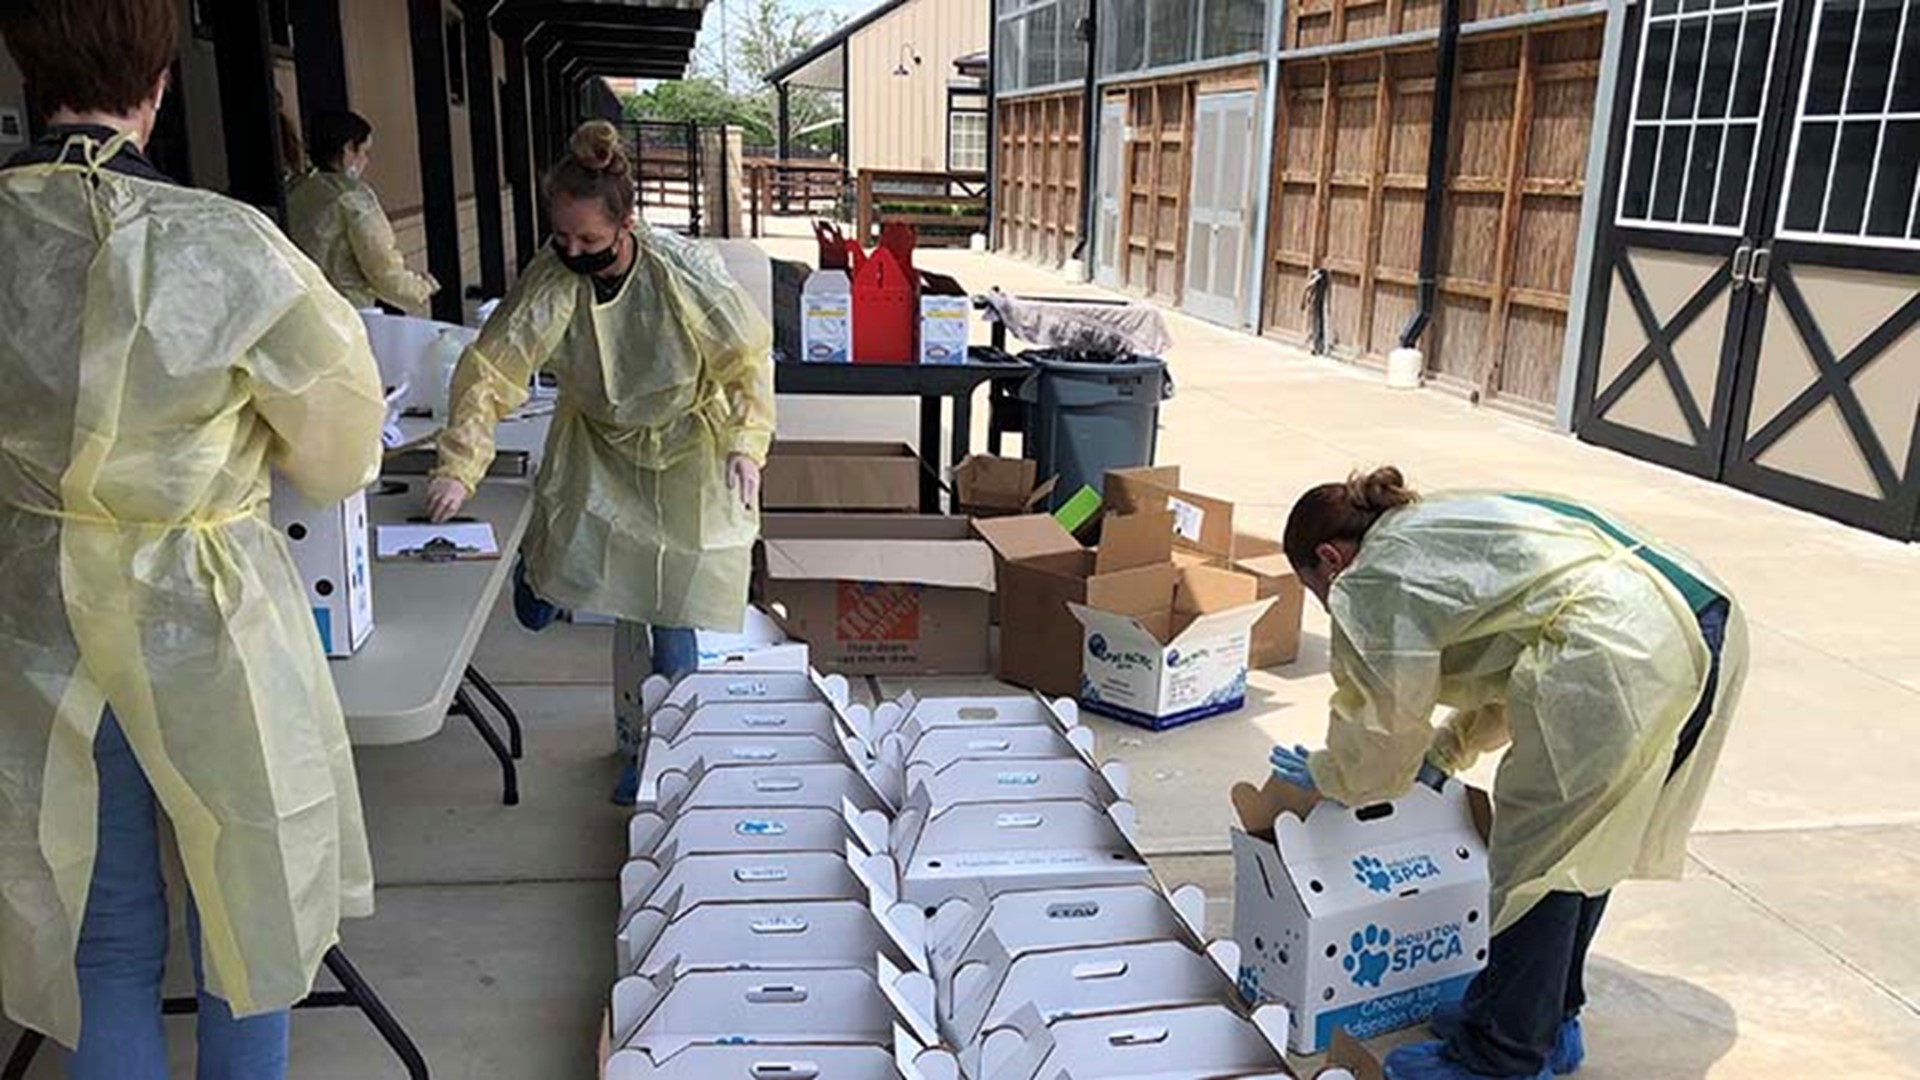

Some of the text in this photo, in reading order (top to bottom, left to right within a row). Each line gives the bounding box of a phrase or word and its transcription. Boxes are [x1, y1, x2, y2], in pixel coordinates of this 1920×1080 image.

[1390, 862, 1441, 884] SPCA
[1394, 922, 1462, 946] HOUSTON
[1392, 934, 1463, 972] SPCA
[1361, 993, 1415, 1016] Choose
